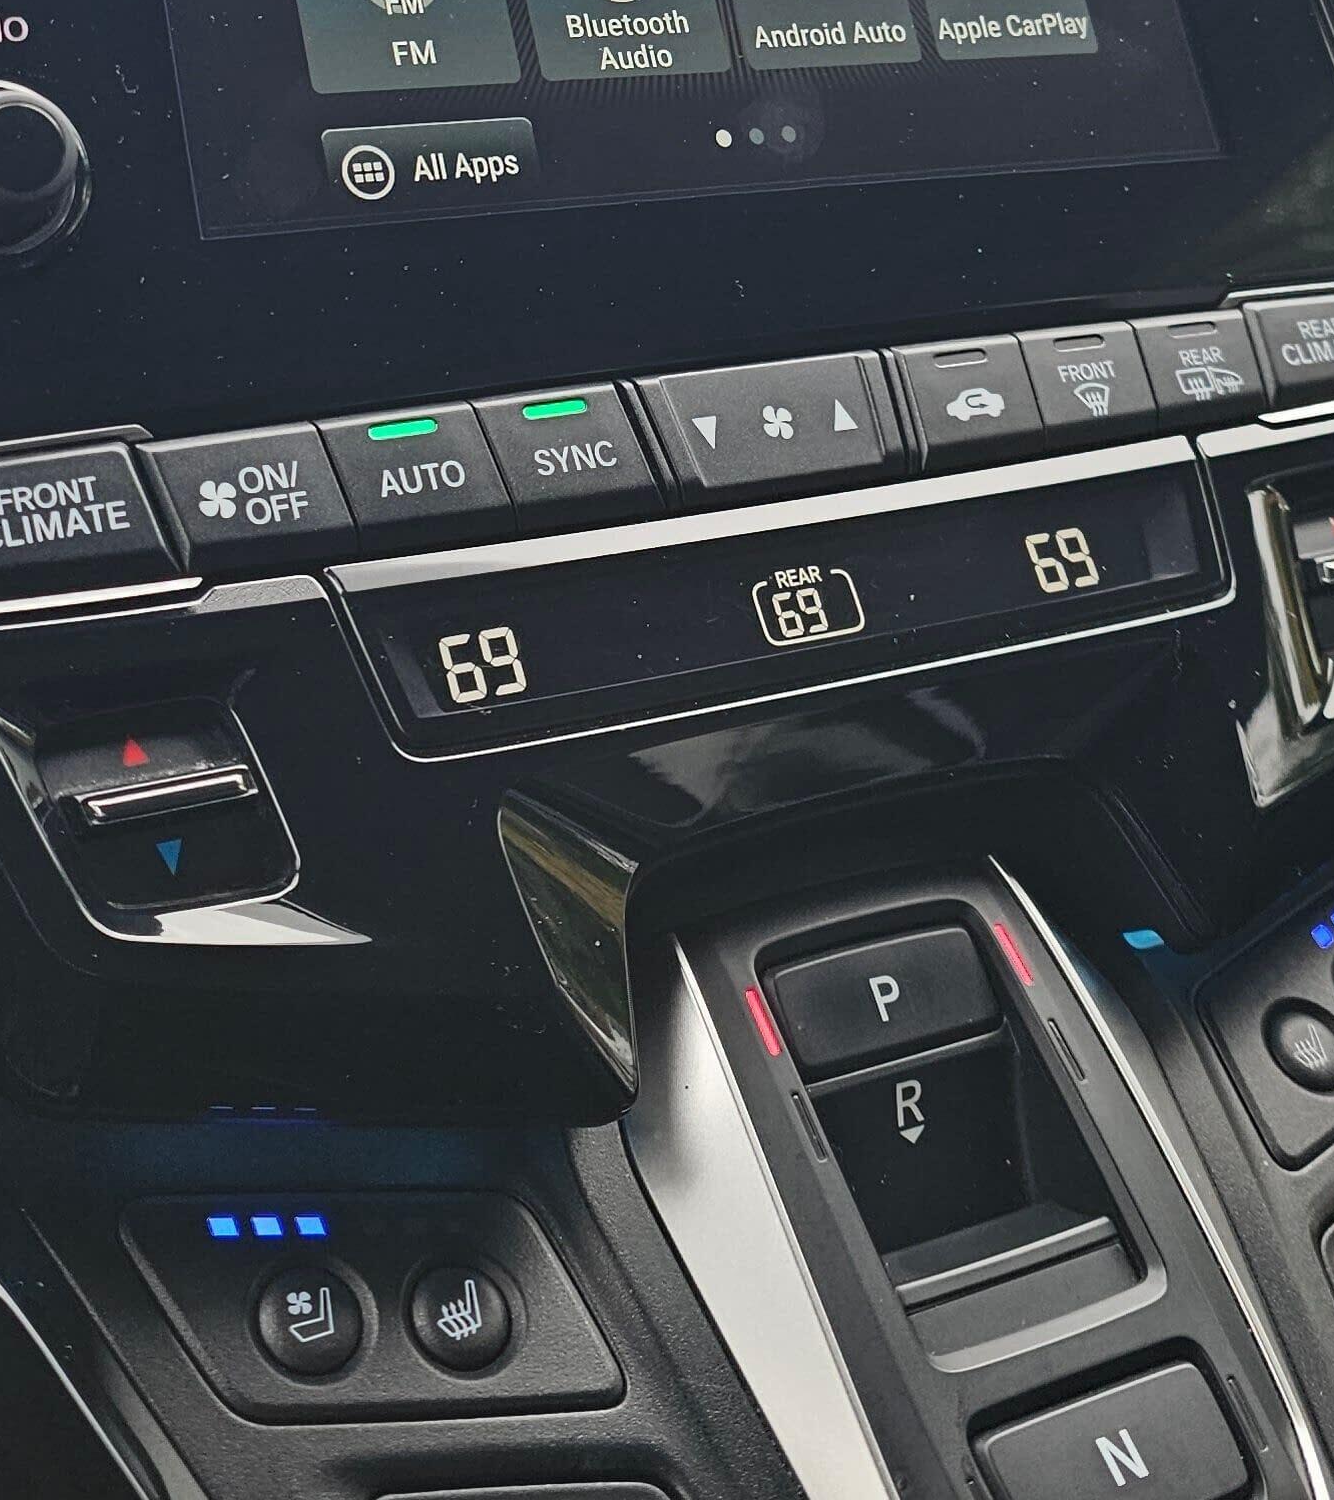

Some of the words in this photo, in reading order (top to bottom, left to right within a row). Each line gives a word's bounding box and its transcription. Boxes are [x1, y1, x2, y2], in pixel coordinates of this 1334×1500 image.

[565, 10, 691, 39] Bluetooth
[754, 23, 847, 49] Android
[852, 22, 907, 46] Auto
[937, 17, 1001, 44] Apple
[1006, 13, 1089, 39] CarPlay
[391, 39, 438, 66] FM
[599, 45, 674, 71] Audio
[413, 154, 447, 182] All
[454, 150, 520, 182] Apps
[1058, 359, 1116, 385] FRONT
[1179, 345, 1226, 368] REAR
[534, 440, 617, 477] SYNC
[238, 461, 299, 494] ON/
[379, 460, 466, 498] AUTO
[245, 491, 309, 525] OFF
[774, 566, 822, 587] REAR
[1025, 528, 1100, 593] 69
[772, 589, 828, 638] 69
[439, 626, 527, 703] 69
[868, 976, 901, 1022] P
[895, 1079, 925, 1127] R
[1095, 1427, 1151, 1487] N
